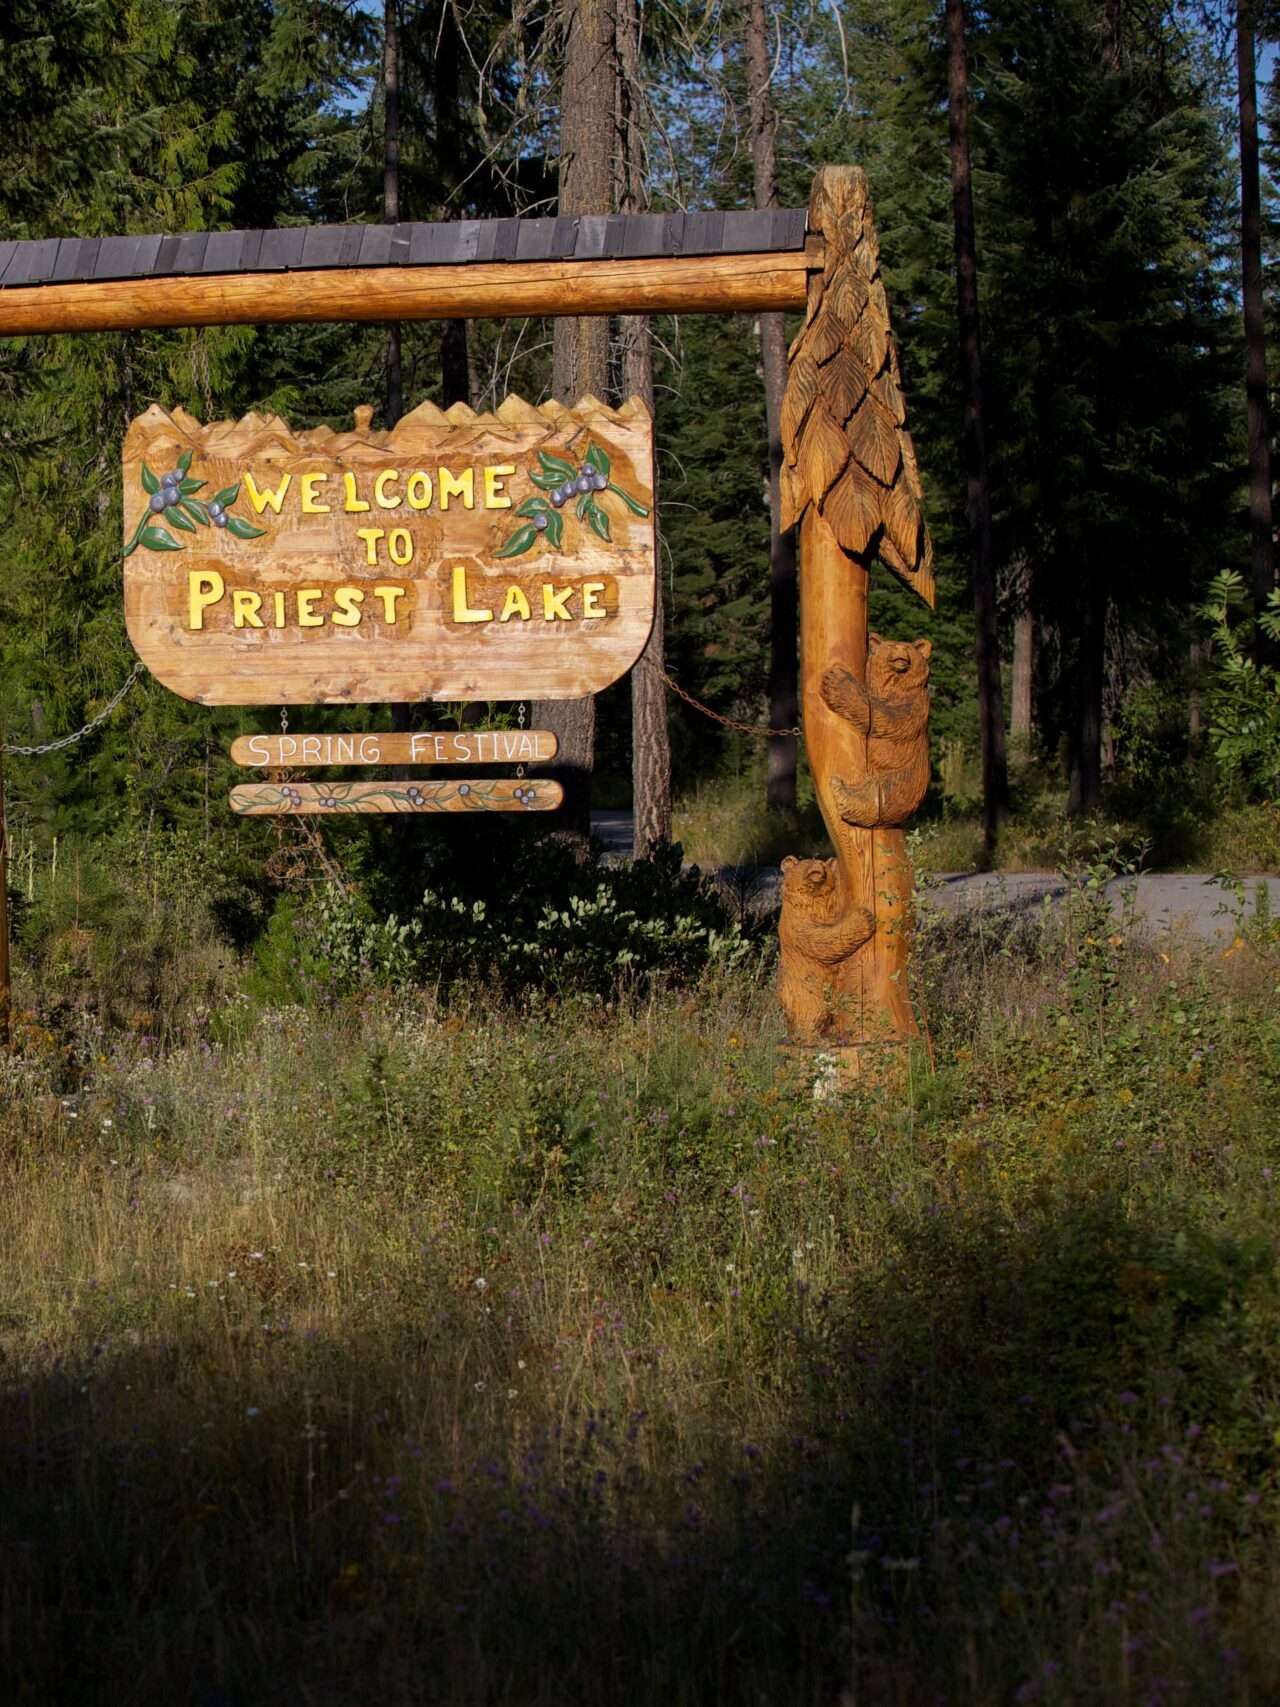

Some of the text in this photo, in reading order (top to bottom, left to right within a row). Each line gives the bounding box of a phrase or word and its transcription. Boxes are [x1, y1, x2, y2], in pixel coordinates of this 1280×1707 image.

[243, 465, 516, 515] WELCOME
[357, 527, 414, 565] TO
[188, 567, 607, 630] PRIEST LAKE
[248, 733, 550, 766] SPRING FESTIVAL
